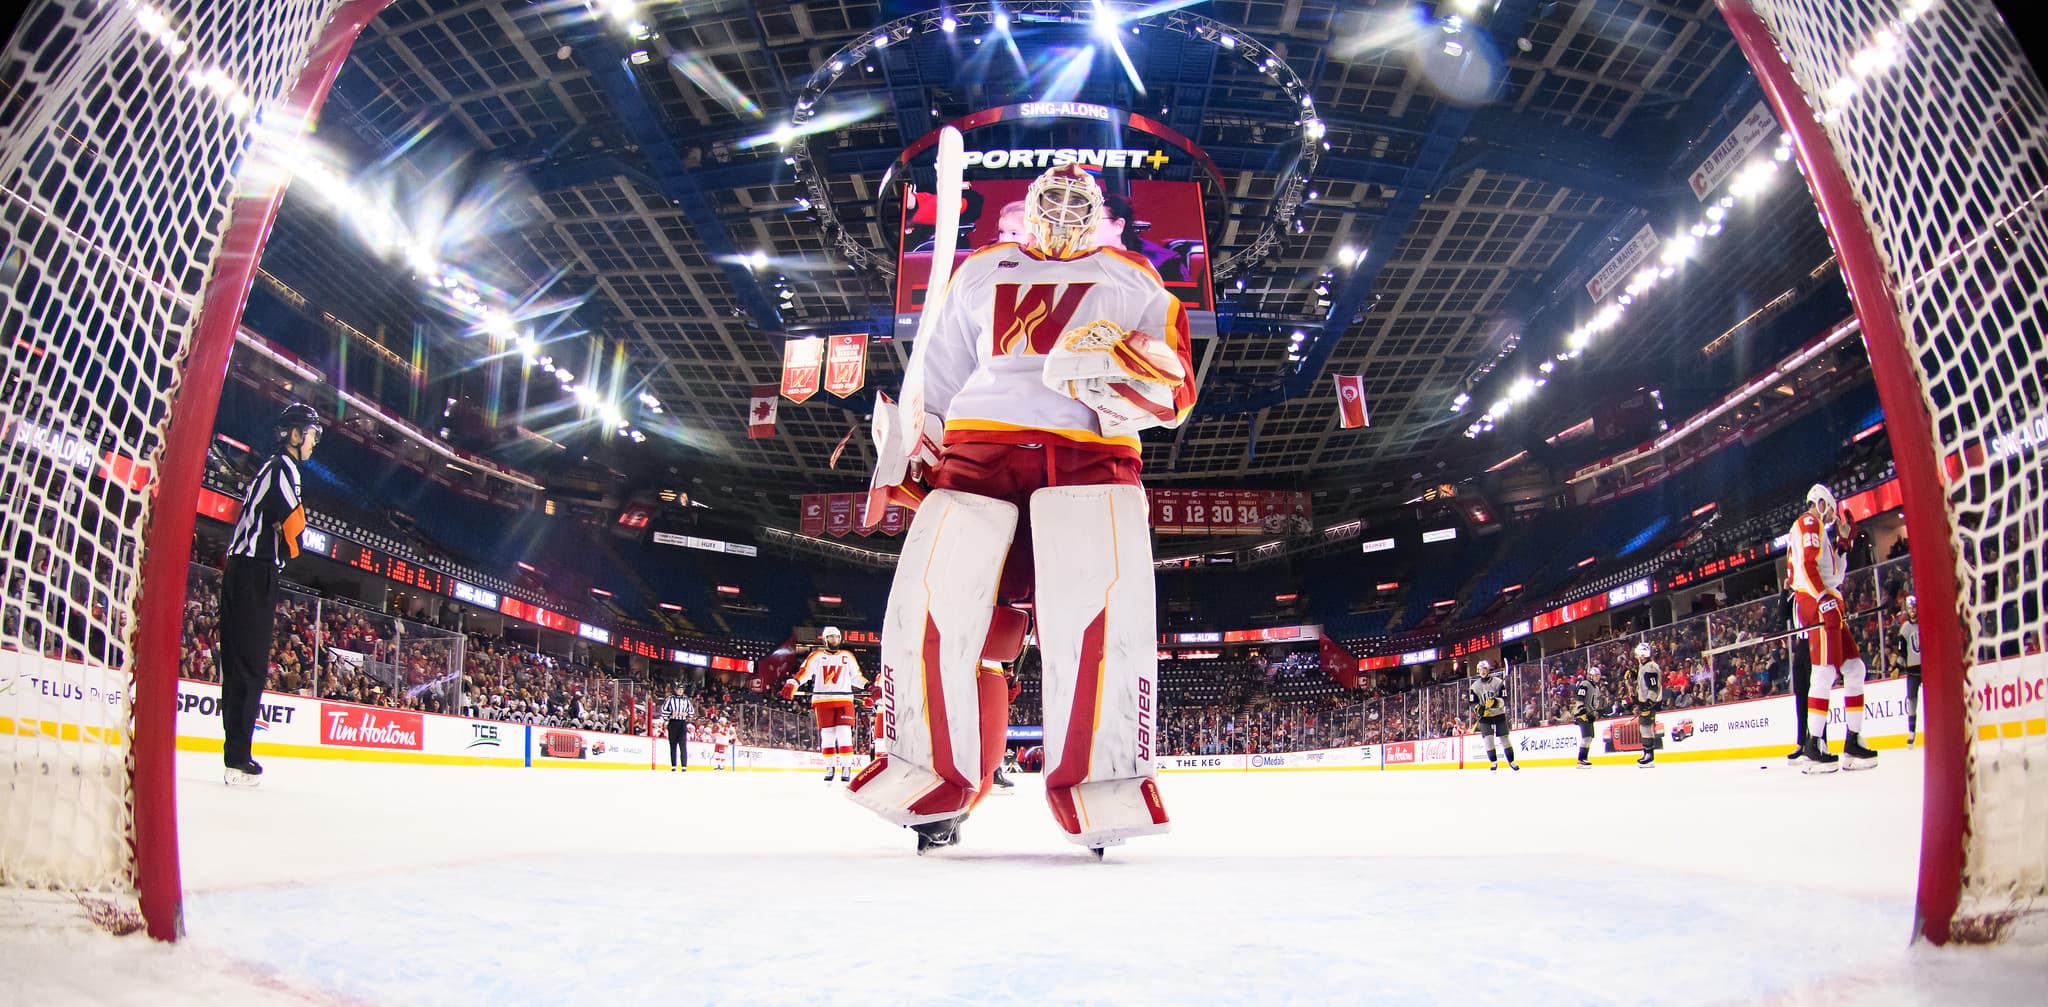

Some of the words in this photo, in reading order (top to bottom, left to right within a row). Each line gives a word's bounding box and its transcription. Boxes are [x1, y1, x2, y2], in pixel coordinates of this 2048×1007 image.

[1020, 102, 1110, 119] SING-ALONG
[934, 149, 1169, 170] PORTSNET+
[1703, 160, 1716, 174] ED
[1711, 134, 1740, 165] WHALEN
[1598, 261, 1619, 283] PETER
[1616, 241, 1639, 265] MAHER
[991, 282, 1098, 357] W
[1163, 505, 1173, 522] 9
[1186, 505, 1205, 523] 12
[1211, 506, 1233, 523] 30
[1238, 506, 1259, 523] 34
[1610, 578, 1649, 605] SING-ALONG
[842, 656, 848, 664] C
[822, 665, 843, 685] W
[31, 678, 83, 700] TELUS
[884, 664, 896, 741] BAUER
[1138, 676, 1150, 761] BAUER
[1700, 721, 1719, 733] Jeep
[1727, 717, 1769, 731] WRANGLER
[328, 711, 357, 742] Tim
[358, 712, 417, 746] Hortons
[471, 723, 498, 739] TCS
[1530, 736, 1578, 751] PLAYALBERTA
[1176, 759, 1197, 767] THE
[1201, 758, 1221, 767] KEG
[1264, 756, 1285, 766] Medals
